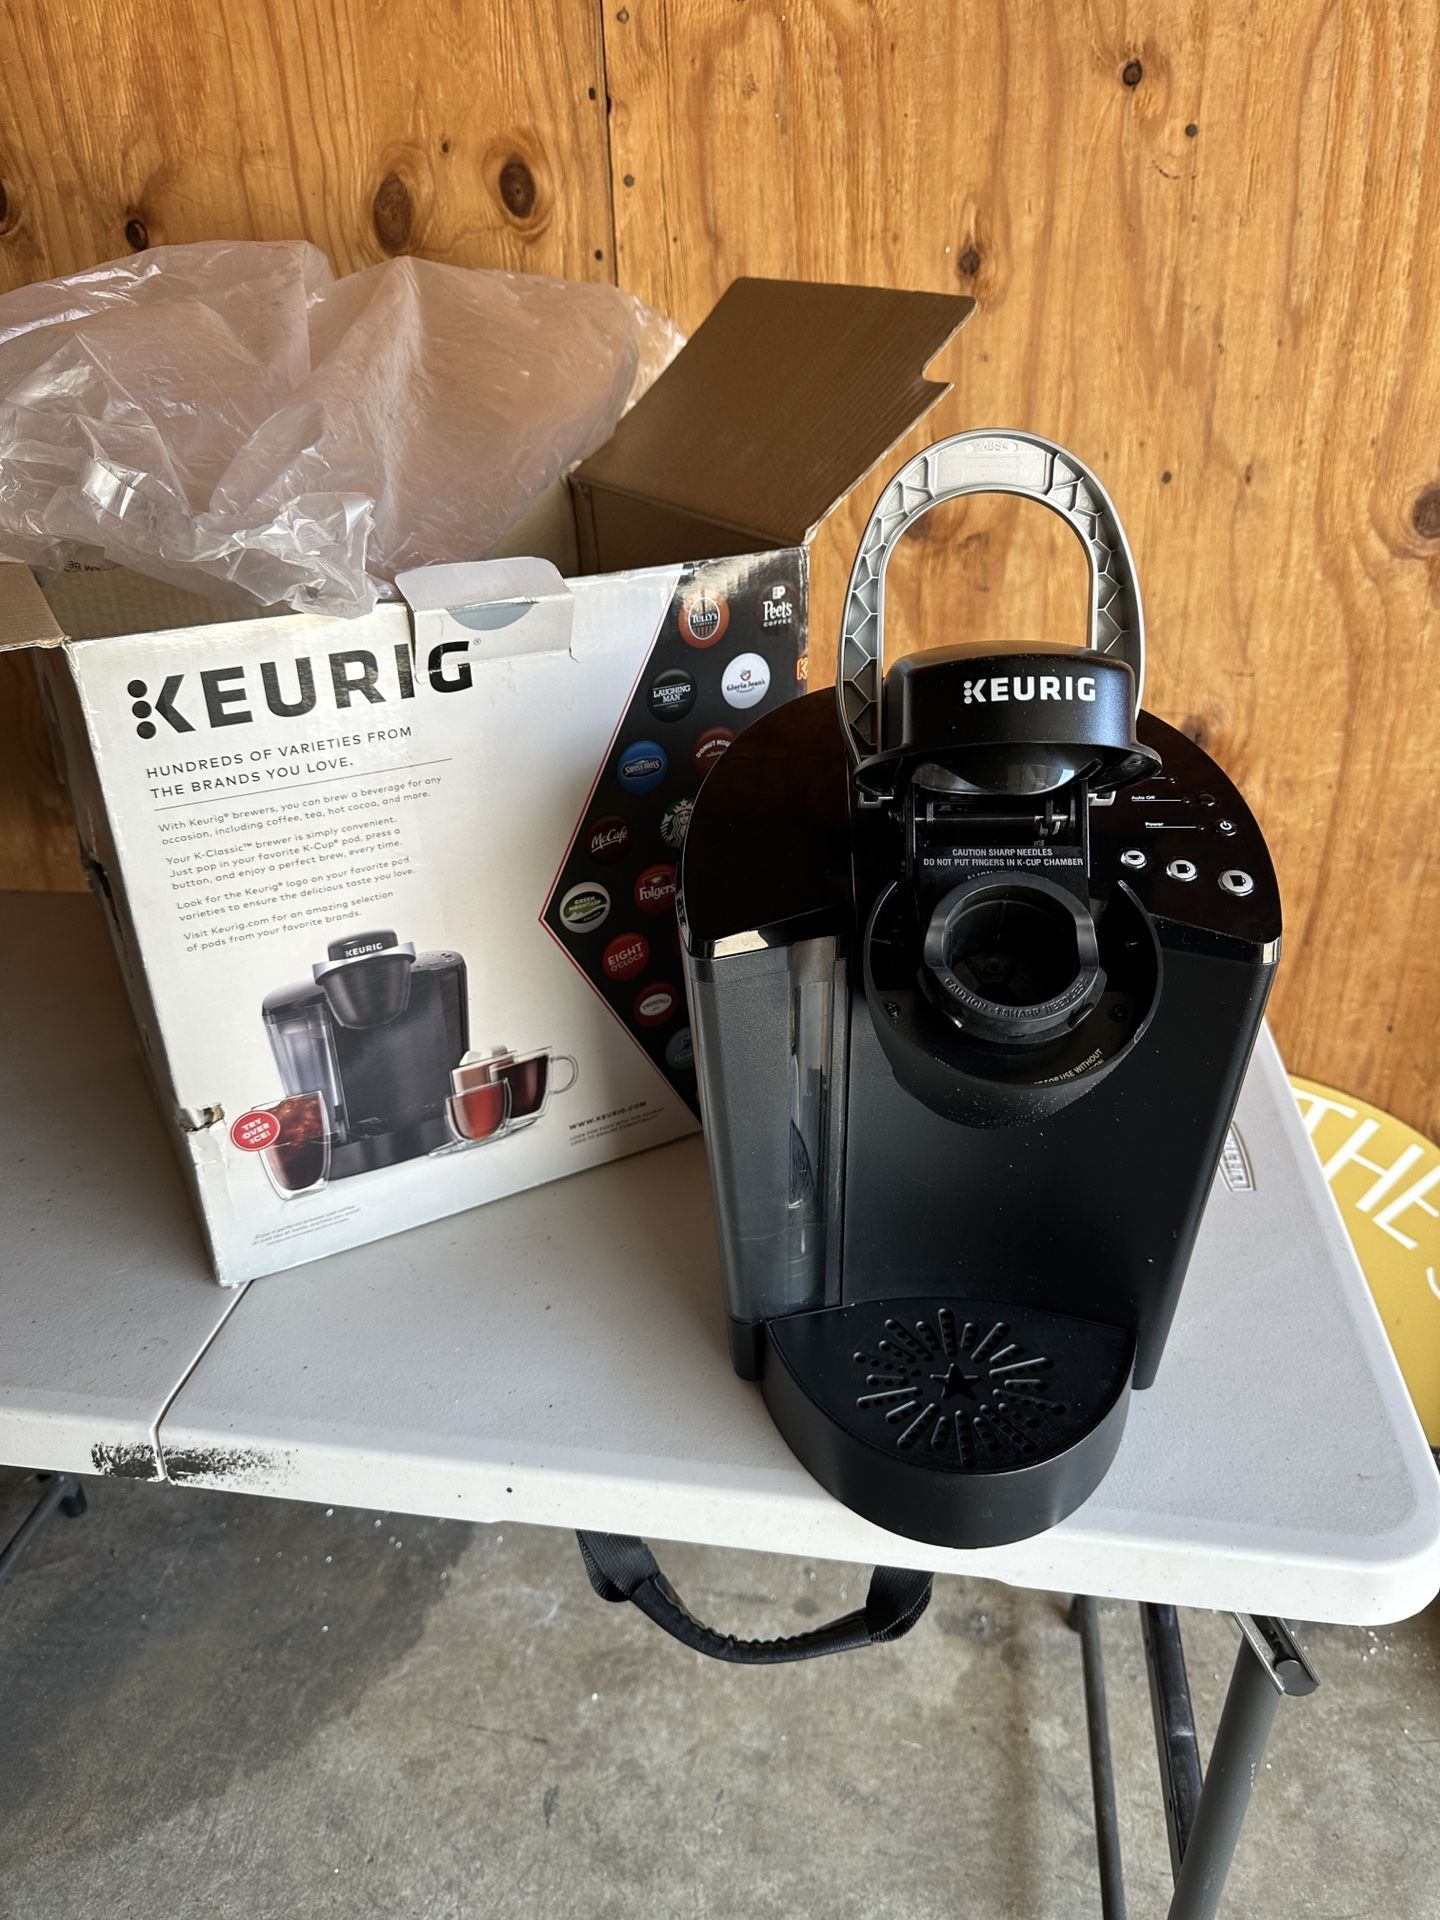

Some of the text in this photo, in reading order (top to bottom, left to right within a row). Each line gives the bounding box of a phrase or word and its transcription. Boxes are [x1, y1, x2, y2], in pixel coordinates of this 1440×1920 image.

[763, 618, 792, 628] COFFEE
[653, 684, 691, 698] LAUGHING
[662, 694, 681, 704] MAN
[726, 682, 747, 692] Gloria
[963, 676, 1096, 705] KEURIG
[146, 726, 412, 779] HUNDREDS OF VARIETIES FROM
[695, 740, 715, 759] DONUT
[150, 756, 354, 799] THE BRANDS YOU LOVE.
[157, 820, 187, 832] With
[280, 802, 300, 813] you
[301, 798, 321, 807] can
[322, 793, 348, 804] brew
[350, 791, 358, 799] a
[359, 783, 406, 797] beverage
[407, 779, 422, 788] for
[424, 776, 442, 785] any
[214, 821, 264, 836] including
[327, 806, 345, 815] hot
[381, 794, 401, 805] and
[164, 855, 191, 865] Your
[254, 836, 292, 849] brewer
[294, 834, 304, 842] is
[305, 827, 339, 840] simply
[169, 867, 194, 878] Just
[195, 863, 217, 874] pop
[231, 855, 255, 868] your
[257, 847, 300, 861] favorite
[364, 829, 392, 842] press
[952, 848, 1053, 857] CAUTION SHARP NEEDLES
[214, 870, 236, 882] and
[237, 866, 266, 878] enjoy
[268, 864, 276, 872] a
[278, 856, 316, 872] perfect
[348, 845, 375, 856] every
[924, 858, 1084, 867] DO NOT PUT FINGERS IN K-CUP CHAMBER
[175, 898, 203, 910] Look
[204, 895, 221, 904] for
[223, 891, 242, 900] the
[285, 878, 308, 888] logo
[310, 875, 324, 883] on
[325, 870, 348, 882] your
[349, 861, 389, 875] favorite
[391, 855, 410, 868] pod
[639, 883, 676, 901] Folgers
[178, 906, 226, 922] varieties
[227, 904, 241, 912] to
[242, 896, 278, 909] ensure
[279, 892, 297, 901] the
[299, 883, 344, 897] delicious
[345, 877, 372, 888] taste
[373, 873, 391, 883] you
[568, 899, 602, 912] MOUNTAIN
[574, 896, 596, 905] GREEN
[182, 891, 394, 940] Visit Keurig.com for an amazing selection
[186, 942, 198, 953] of
[200, 938, 227, 951] pods
[228, 932, 255, 943] from
[256, 927, 280, 939] your
[281, 918, 323, 932] favorite
[346, 942, 383, 958] KEURIG
[608, 942, 642, 966] EIGHT
[944, 977, 987, 1010] CAUTION
[1073, 1048, 1103, 1074] WITHOUT
[241, 1118, 262, 1131] TRY
[242, 1122, 270, 1140] OVER
[247, 1131, 271, 1145] ICE!
